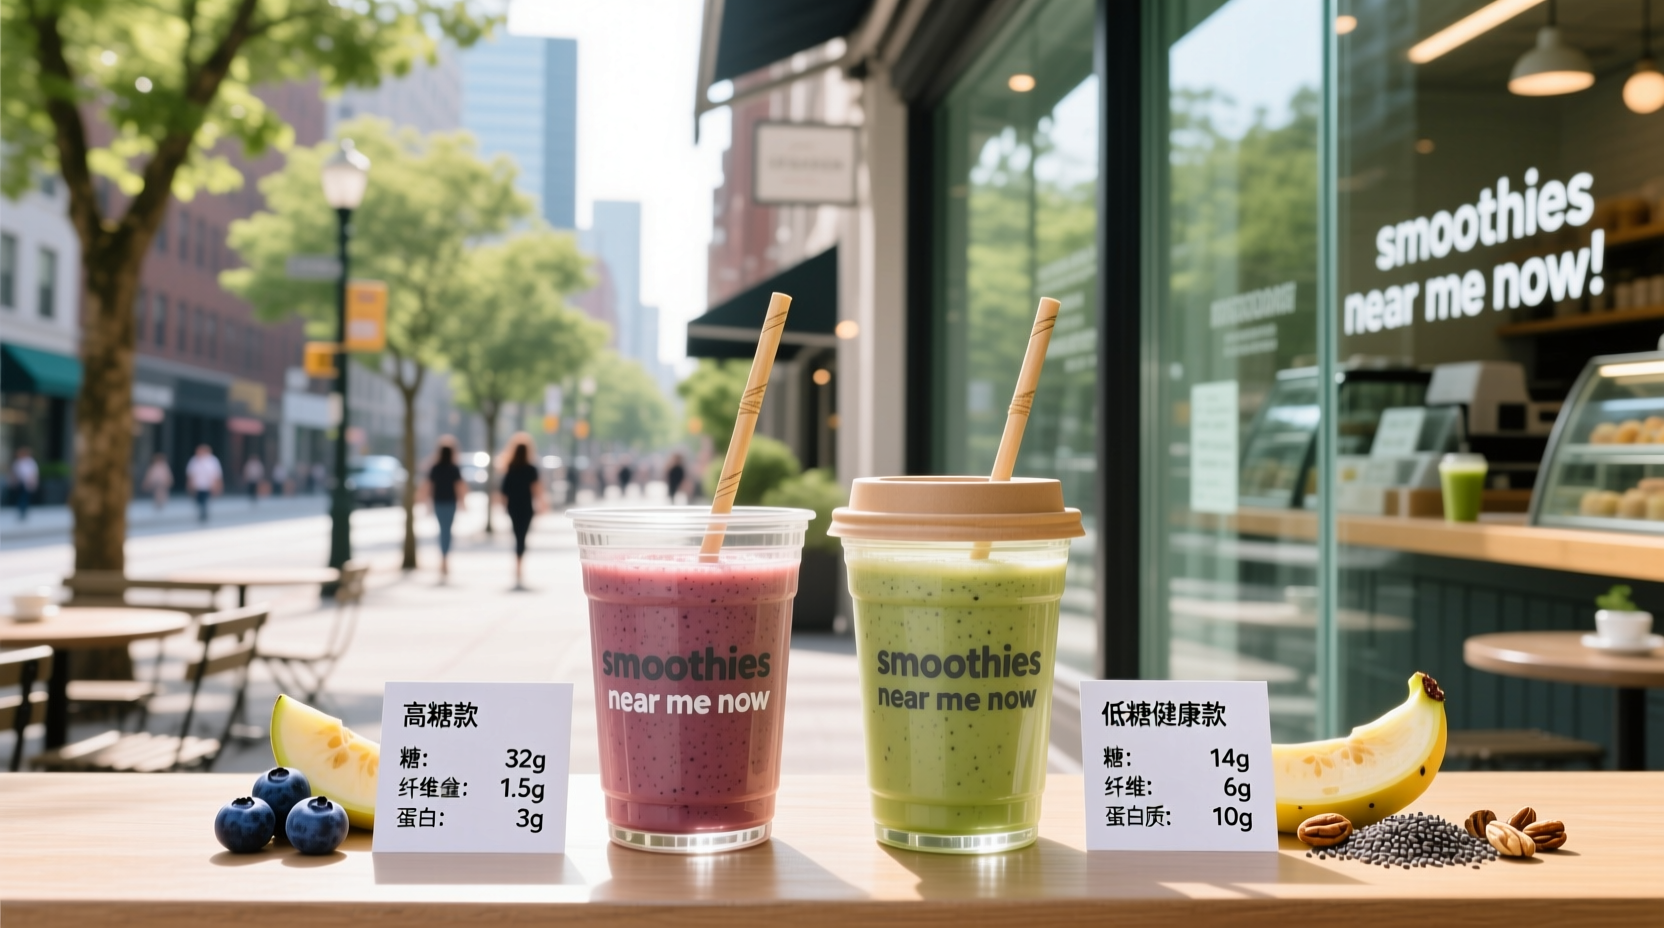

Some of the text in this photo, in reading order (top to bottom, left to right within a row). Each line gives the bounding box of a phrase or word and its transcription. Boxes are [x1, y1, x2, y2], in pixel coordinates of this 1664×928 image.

[1376, 167, 1594, 271] smoothies
[1344, 282, 1419, 336] near
[1425, 269, 1486, 322] me
[1493, 228, 1605, 311] now!
[602, 645, 771, 682] smoothies
[877, 644, 1041, 679] smoothies
[608, 688, 770, 715] near me now
[878, 683, 1037, 711] near me now
[403, 701, 478, 728] 高糖款
[1101, 701, 1227, 727] 低糖健康款
[505, 749, 546, 774] 32g
[1210, 748, 1249, 773] 14g
[500, 778, 545, 804] 1.5g
[1224, 777, 1251, 802] 6g
[516, 808, 543, 833] 3g
[1212, 807, 1253, 832] 10g
